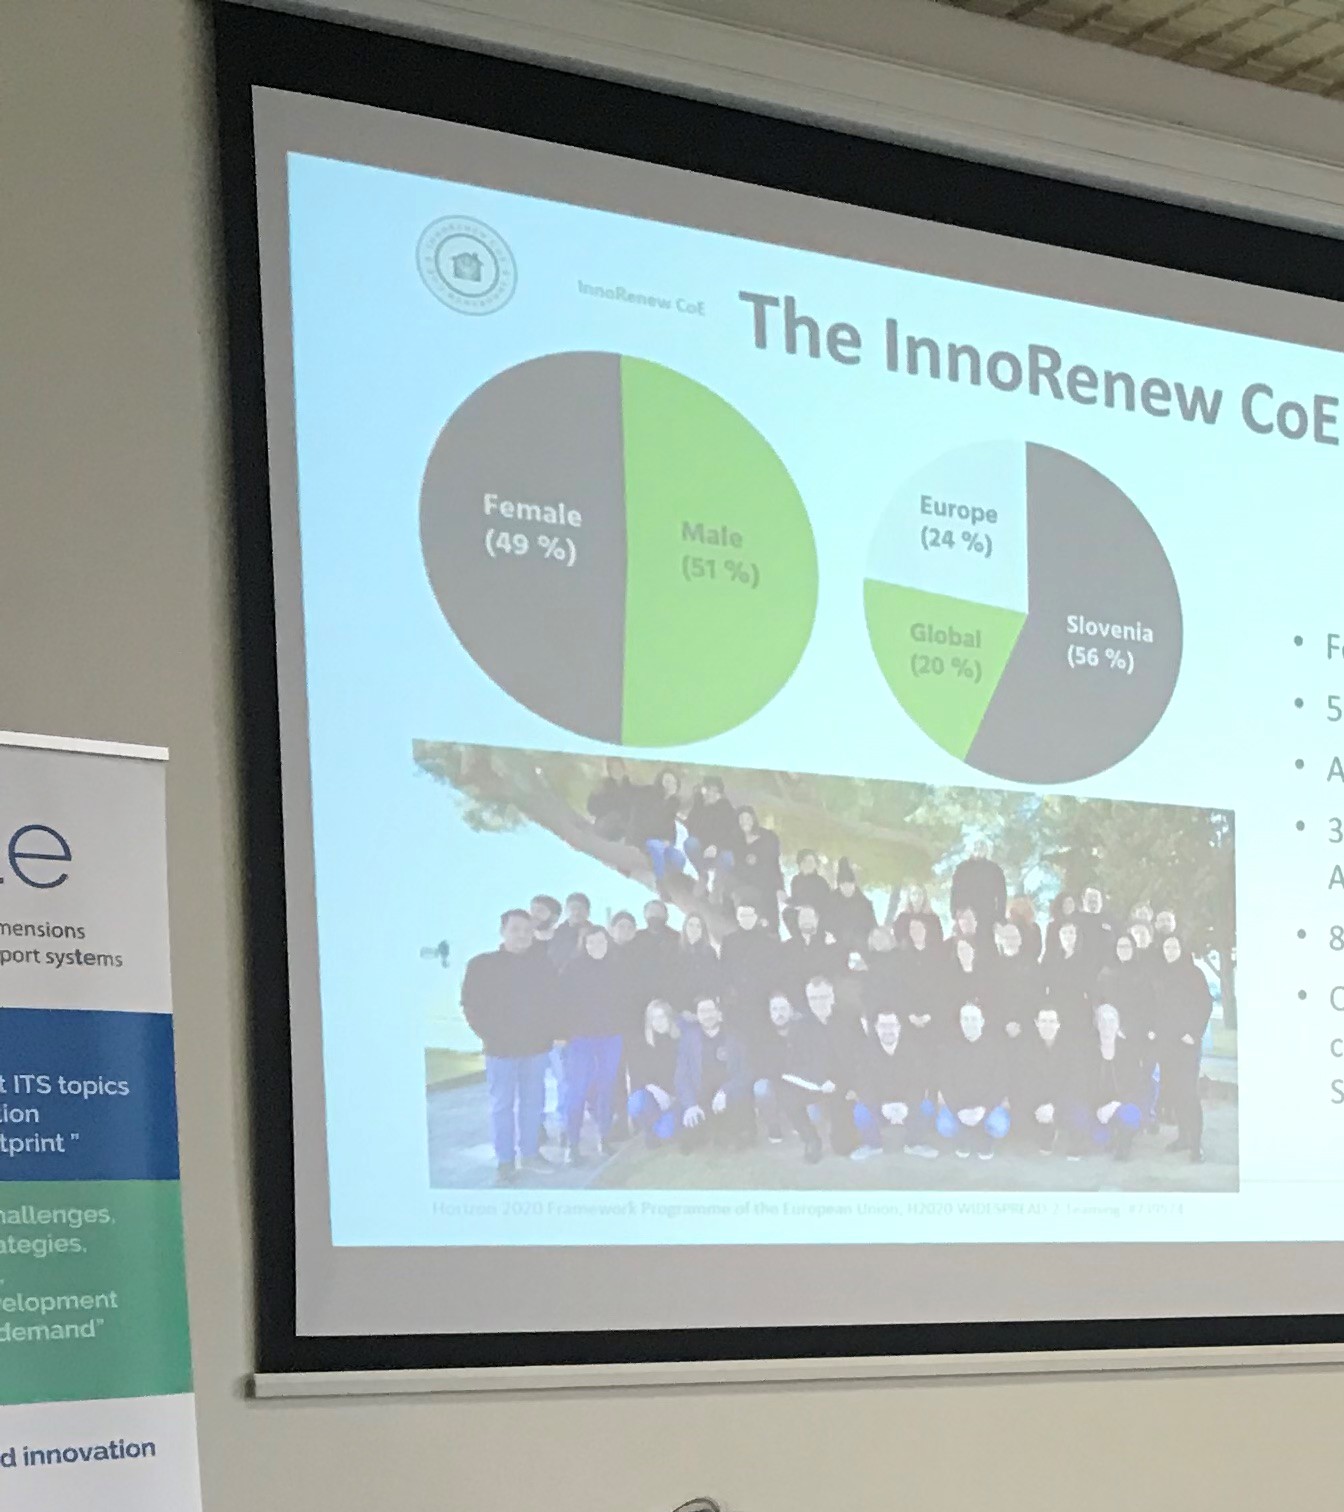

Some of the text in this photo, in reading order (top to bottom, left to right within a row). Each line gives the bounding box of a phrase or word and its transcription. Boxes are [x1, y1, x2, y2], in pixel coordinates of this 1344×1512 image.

[578, 279, 706, 317] InnoRenew CoE
[738, 290, 862, 365] The
[885, 318, 1223, 425] InnoRenew
[1241, 382, 1340, 446] CoE
[483, 492, 583, 528] Female
[919, 494, 999, 527] Europe
[484, 528, 578, 568] (49 %)
[680, 520, 744, 550] Male
[919, 525, 993, 558] (24 %)
[681, 553, 761, 590] (51 %)
[909, 621, 983, 650] Global
[1066, 613, 1154, 644] Slovenia
[909, 652, 983, 685] (20 %)
[1066, 643, 1135, 675] (56 %)
[46, 949, 123, 969] systems
[14, 1075, 51, 1094] ITS
[58, 1076, 130, 1099] topics
[432, 1201, 497, 1216] Horizon
[502, 1202, 543, 1216] 2020
[547, 1201, 636, 1216] Framework
[641, 1201, 731, 1219] Programme
[734, 1201, 749, 1216] of
[753, 1202, 778, 1216] the
[782, 1201, 852, 1219] European
[0, 1290, 118, 1315] elopment
[23, 1439, 156, 1467] innovation
